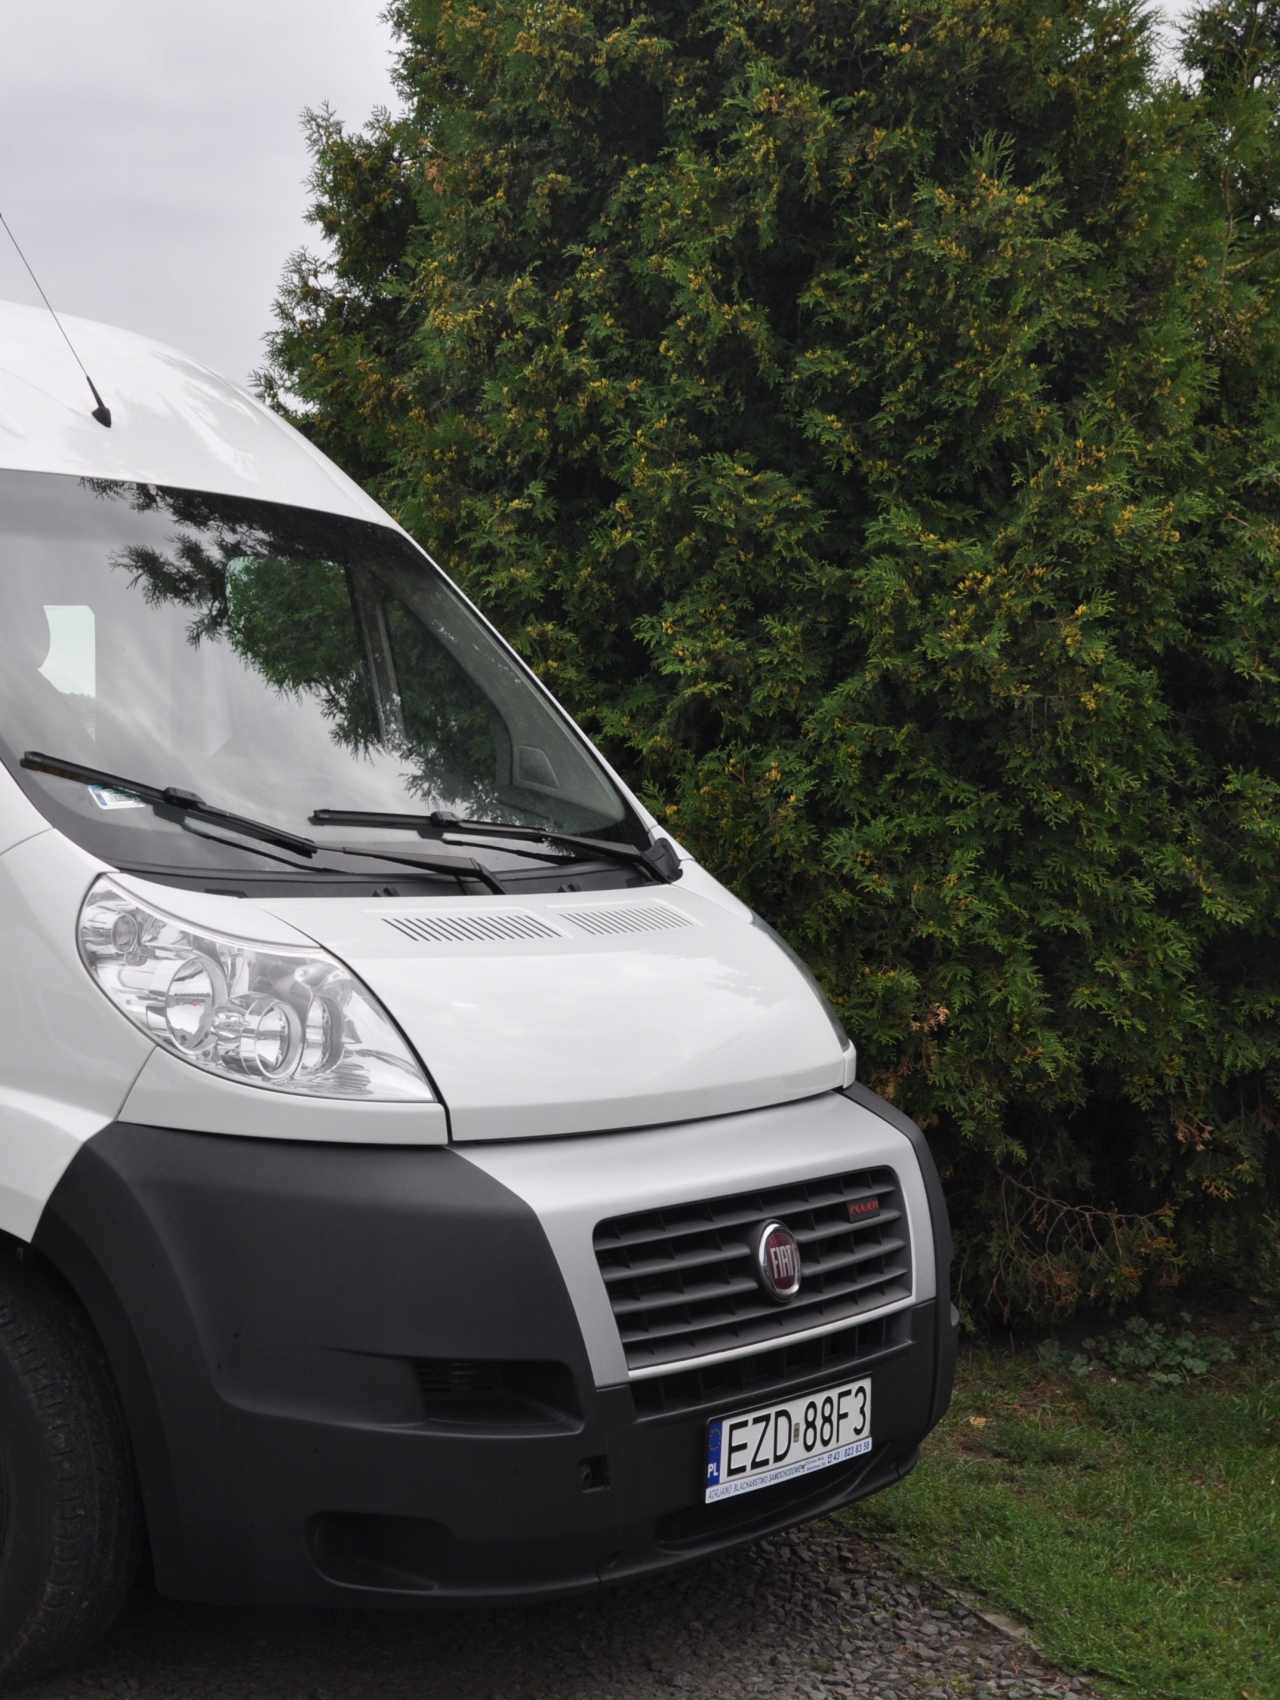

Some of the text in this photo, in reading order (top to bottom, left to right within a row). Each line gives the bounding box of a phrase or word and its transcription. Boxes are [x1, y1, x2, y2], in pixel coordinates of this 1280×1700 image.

[850, 1200, 879, 1214] POWER
[770, 1244, 795, 1279] FIAT
[833, 1451, 840, 1460] 43
[707, 1462, 719, 1478] PL
[733, 1475, 768, 1492] BLACHARSTWO
